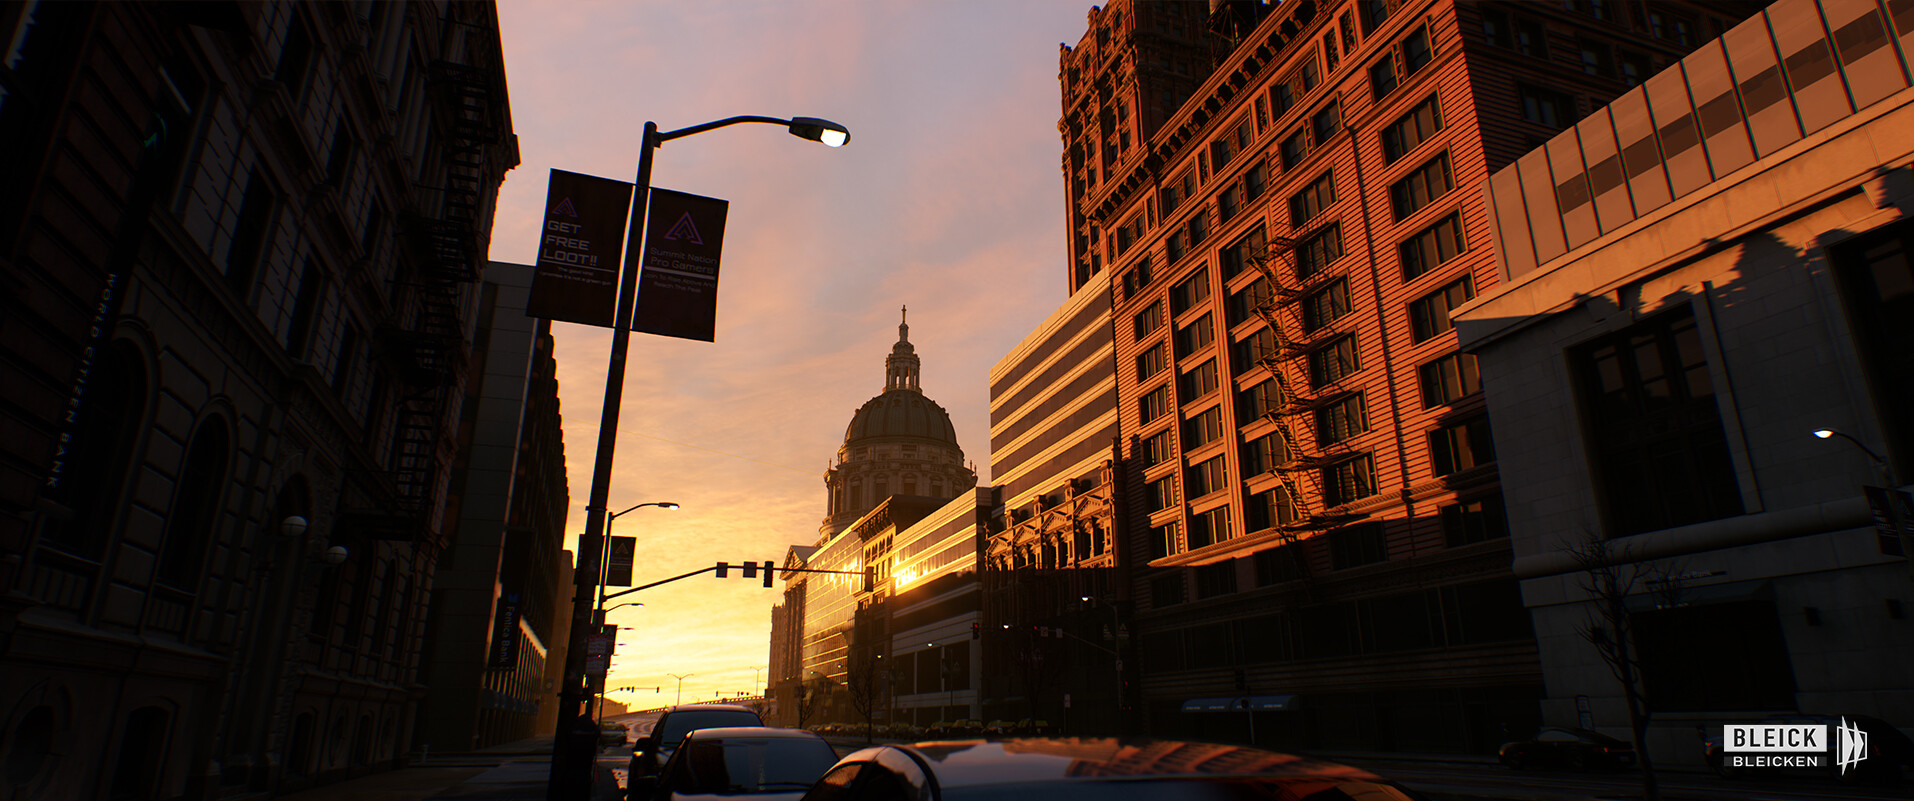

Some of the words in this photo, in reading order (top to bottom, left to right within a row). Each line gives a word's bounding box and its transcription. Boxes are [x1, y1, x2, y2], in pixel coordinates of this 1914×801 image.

[547, 220, 582, 234] GET
[545, 234, 591, 251] FREE
[543, 248, 599, 267] LOOT!!
[650, 247, 686, 260] Summit
[688, 254, 718, 266] Nation
[651, 256, 670, 268] Pro
[672, 260, 715, 275] Gamers
[91, 272, 118, 339] WORLD
[65, 346, 96, 424] CITIZEN
[46, 432, 72, 488] BANK
[499, 640, 511, 664] Bank
